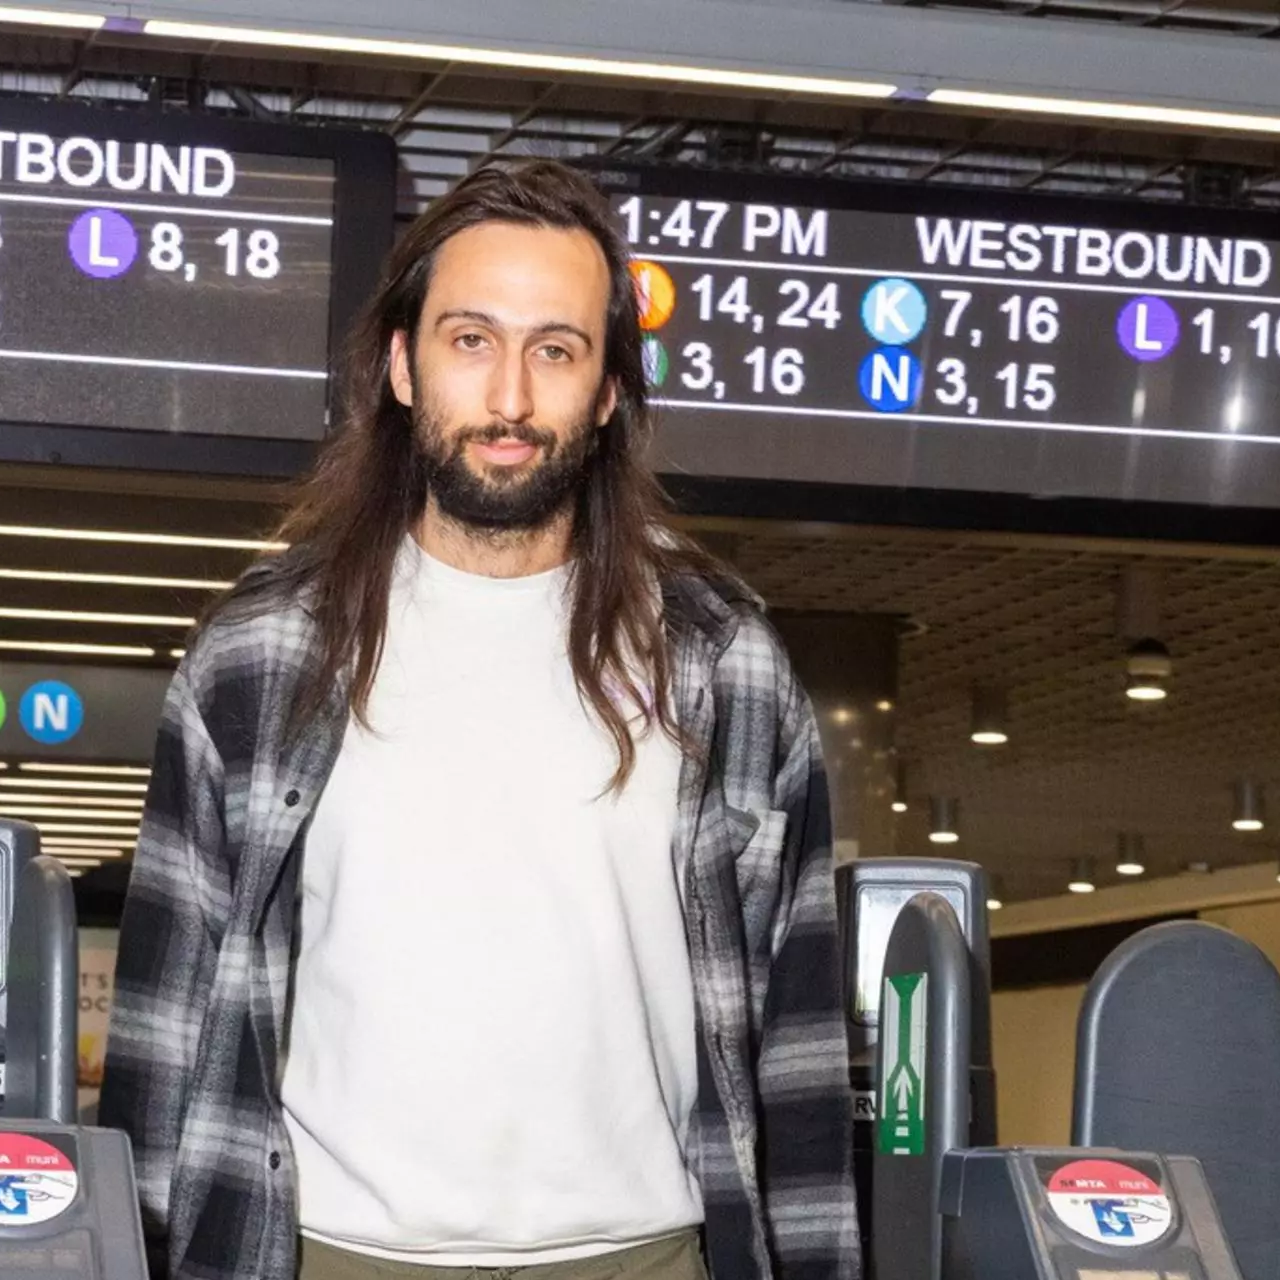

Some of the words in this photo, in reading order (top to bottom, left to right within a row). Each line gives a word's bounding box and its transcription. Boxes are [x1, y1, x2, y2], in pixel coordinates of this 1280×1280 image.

[88, 215, 120, 268] L
[147, 221, 197, 283] 8,
[215, 227, 281, 279] 18
[619, 196, 729, 249] 1:47
[743, 204, 827, 257] PM
[916, 216, 1271, 287] WESTBOUND
[691, 273, 764, 333] 14,
[777, 279, 841, 329] 24
[874, 287, 909, 335] K
[940, 289, 982, 347] 7,
[1000, 295, 1059, 344] 16
[1134, 303, 1163, 351] L
[1193, 308, 1231, 364] 1,
[681, 342, 725, 400] 3,
[744, 346, 804, 395] 16
[871, 354, 910, 401] N
[935, 358, 978, 415] 3,
[995, 362, 1056, 411] 15
[33, 693, 69, 731] N
